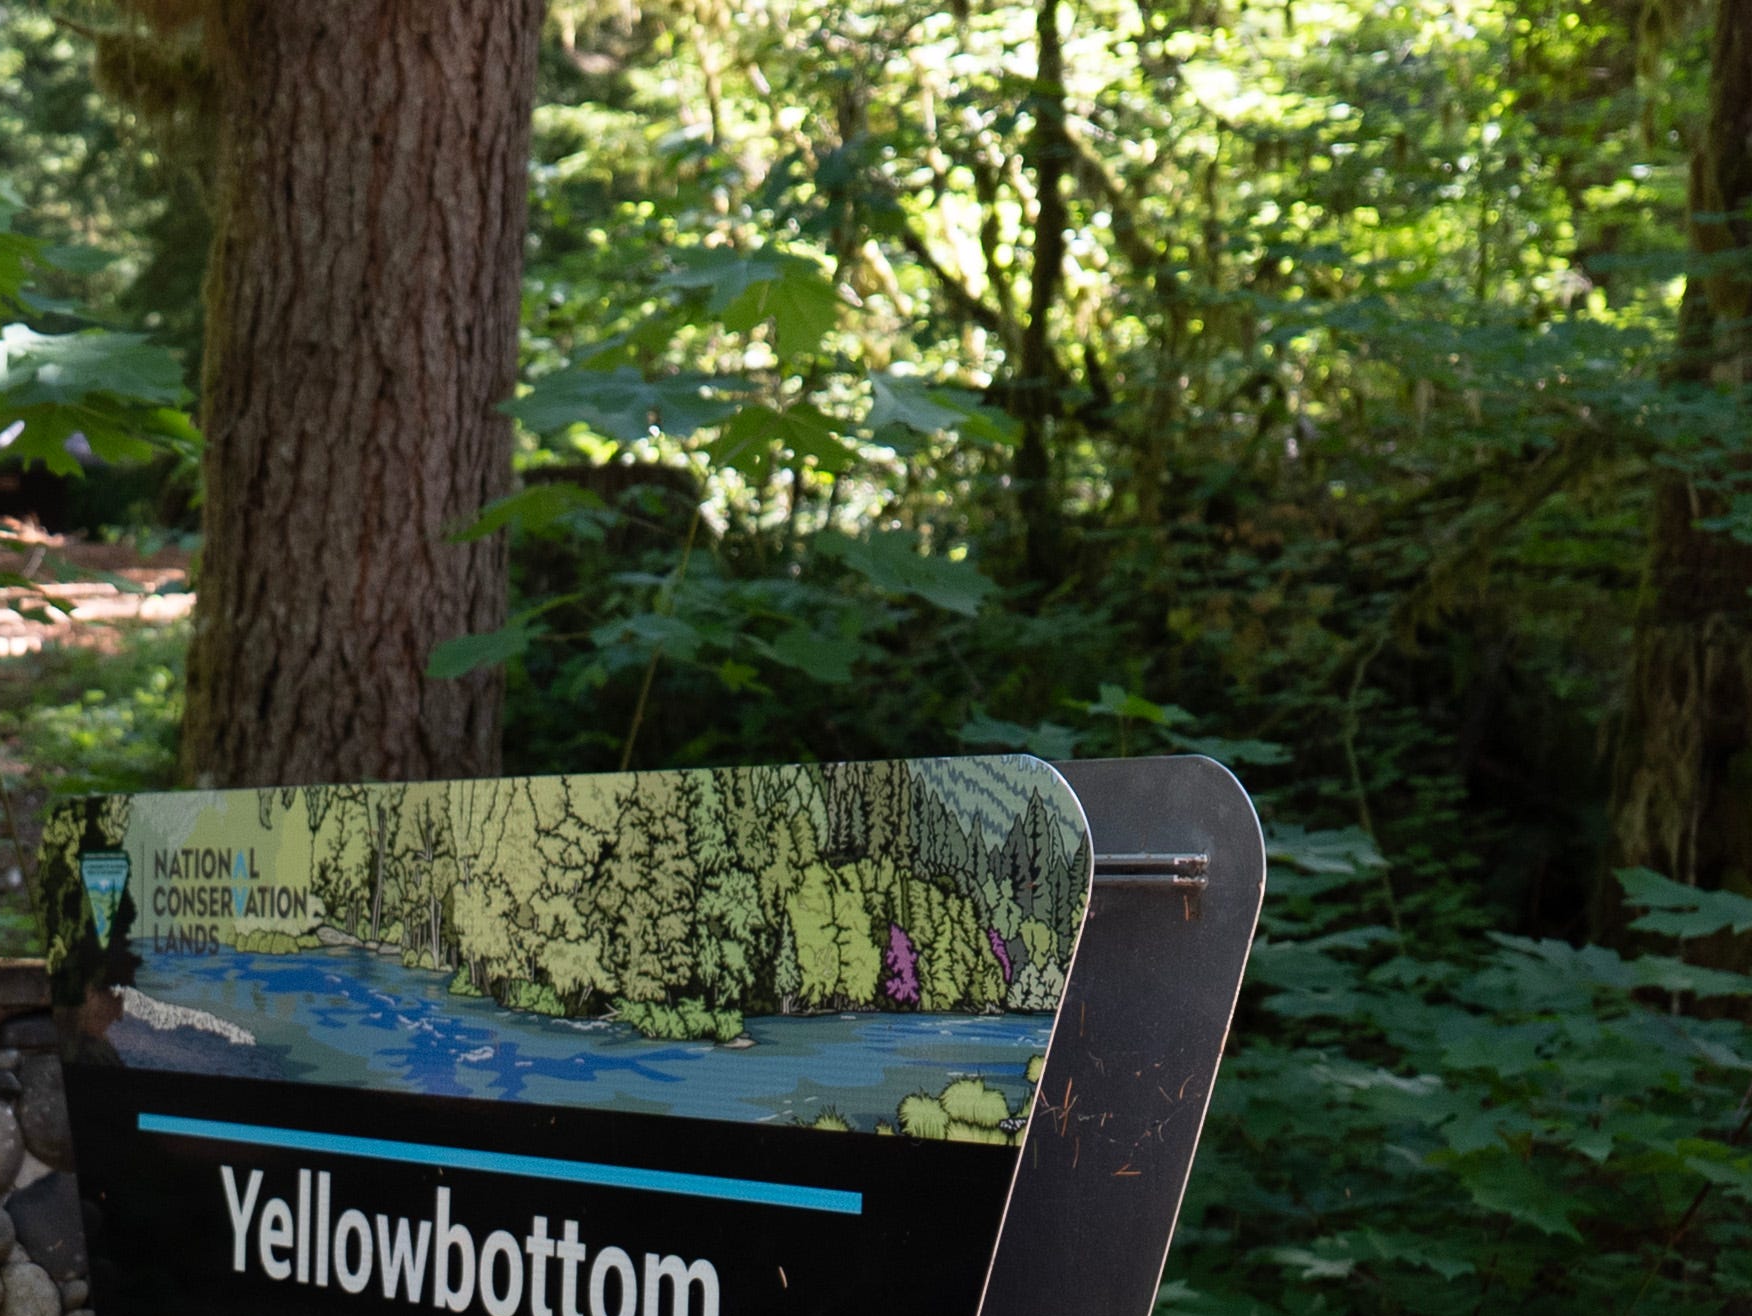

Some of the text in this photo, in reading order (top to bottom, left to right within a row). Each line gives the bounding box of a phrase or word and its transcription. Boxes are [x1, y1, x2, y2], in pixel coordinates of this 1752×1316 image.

[153, 848, 260, 880] NATIONAL
[152, 886, 308, 919] CONSERVATION
[153, 924, 220, 955] LANDS
